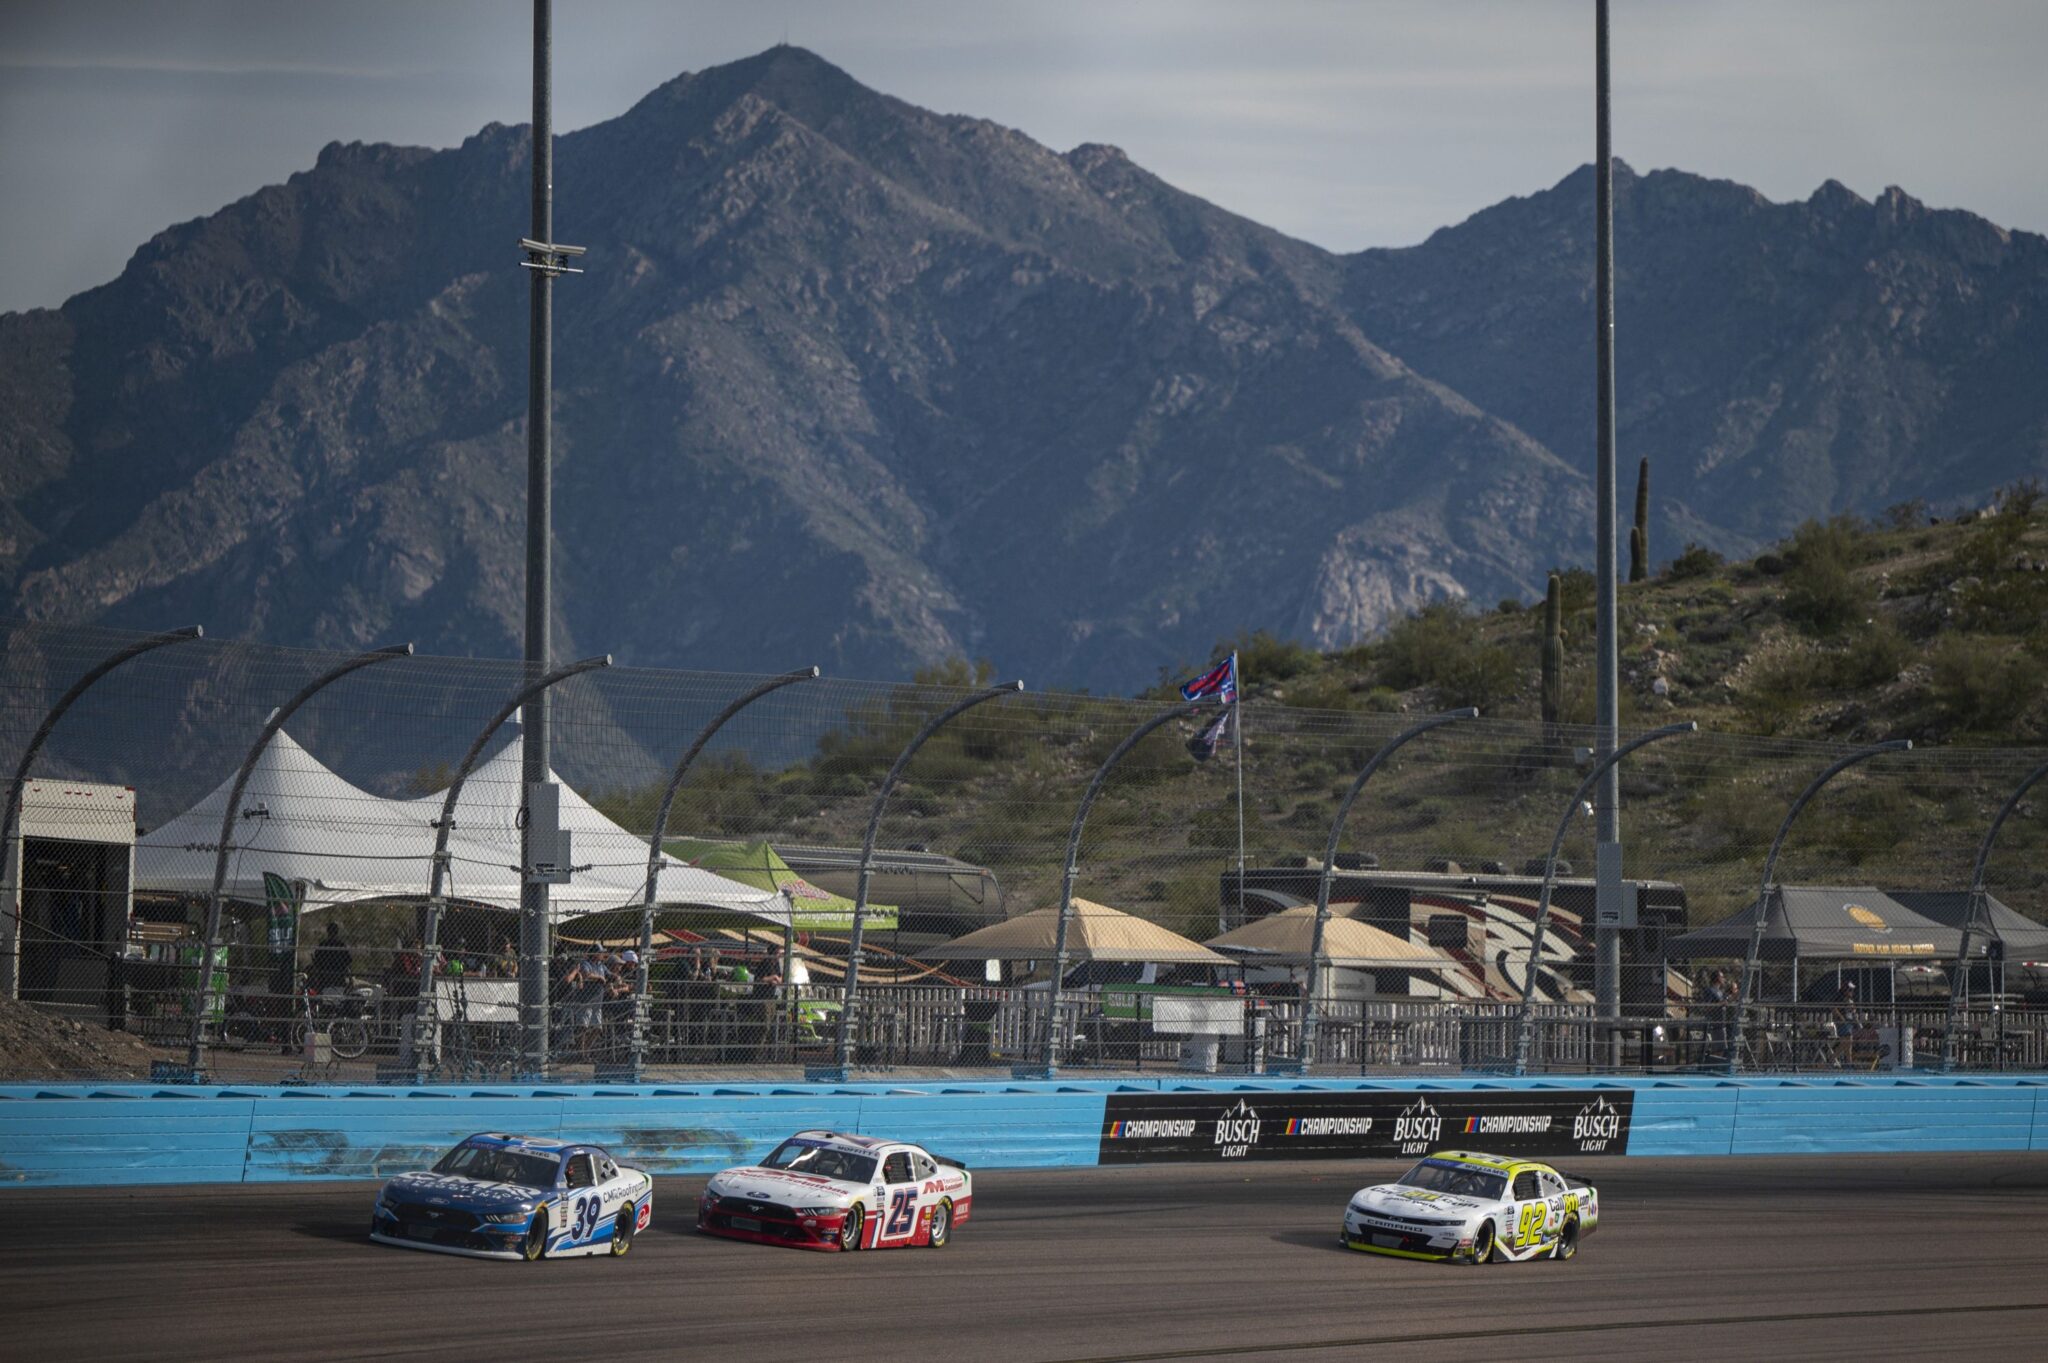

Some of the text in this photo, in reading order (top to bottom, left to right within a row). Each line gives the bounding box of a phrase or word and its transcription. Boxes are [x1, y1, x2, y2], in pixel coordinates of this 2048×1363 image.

[1124, 1119, 1196, 1138] CHAMPIONSHIP
[1214, 1119, 1261, 1144] BUSCH
[1300, 1117, 1373, 1135] CHAMPIONSHIP
[1393, 1117, 1441, 1141] BUSCH
[1479, 1115, 1552, 1133] CHAMPIONSHIP
[1573, 1115, 1619, 1139] BUSCH
[1221, 1144, 1248, 1157] LIGHT
[1401, 1142, 1429, 1154] LIGHT
[1580, 1139, 1608, 1151] LIGHT
[1464, 1163, 1505, 1176] WILLIAMS
[571, 1194, 601, 1241] 39
[884, 1186, 918, 1236] 25
[1367, 1218, 1423, 1233] CAMARO
[1514, 1201, 1547, 1248] 92
